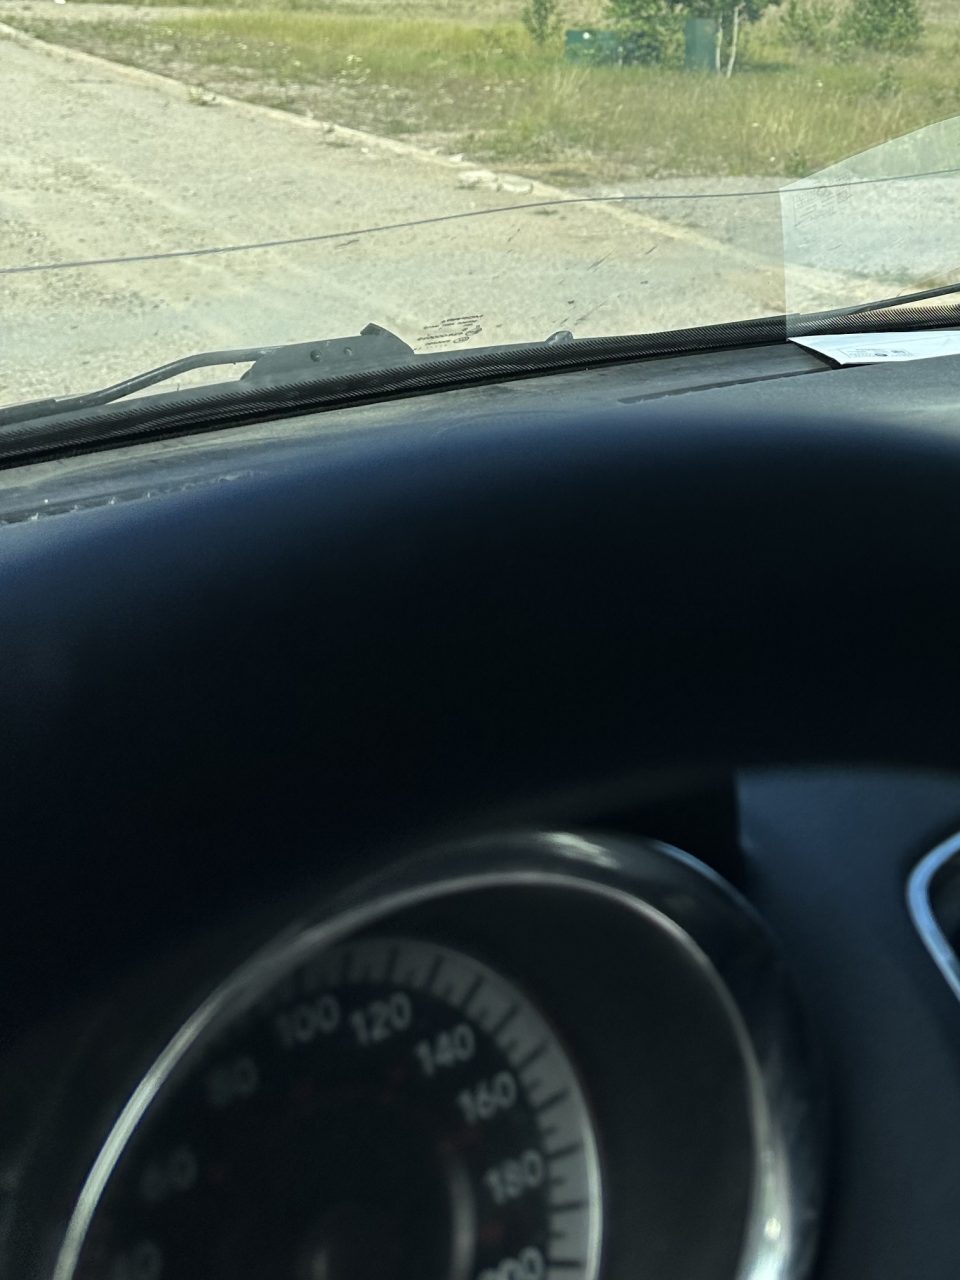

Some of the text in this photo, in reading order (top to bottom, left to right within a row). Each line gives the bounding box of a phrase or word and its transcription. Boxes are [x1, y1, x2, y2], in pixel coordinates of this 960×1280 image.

[351, 991, 412, 1045] 120
[415, 1023, 475, 1077] 140
[457, 1070, 517, 1125] 160
[484, 1150, 544, 1205] 180
